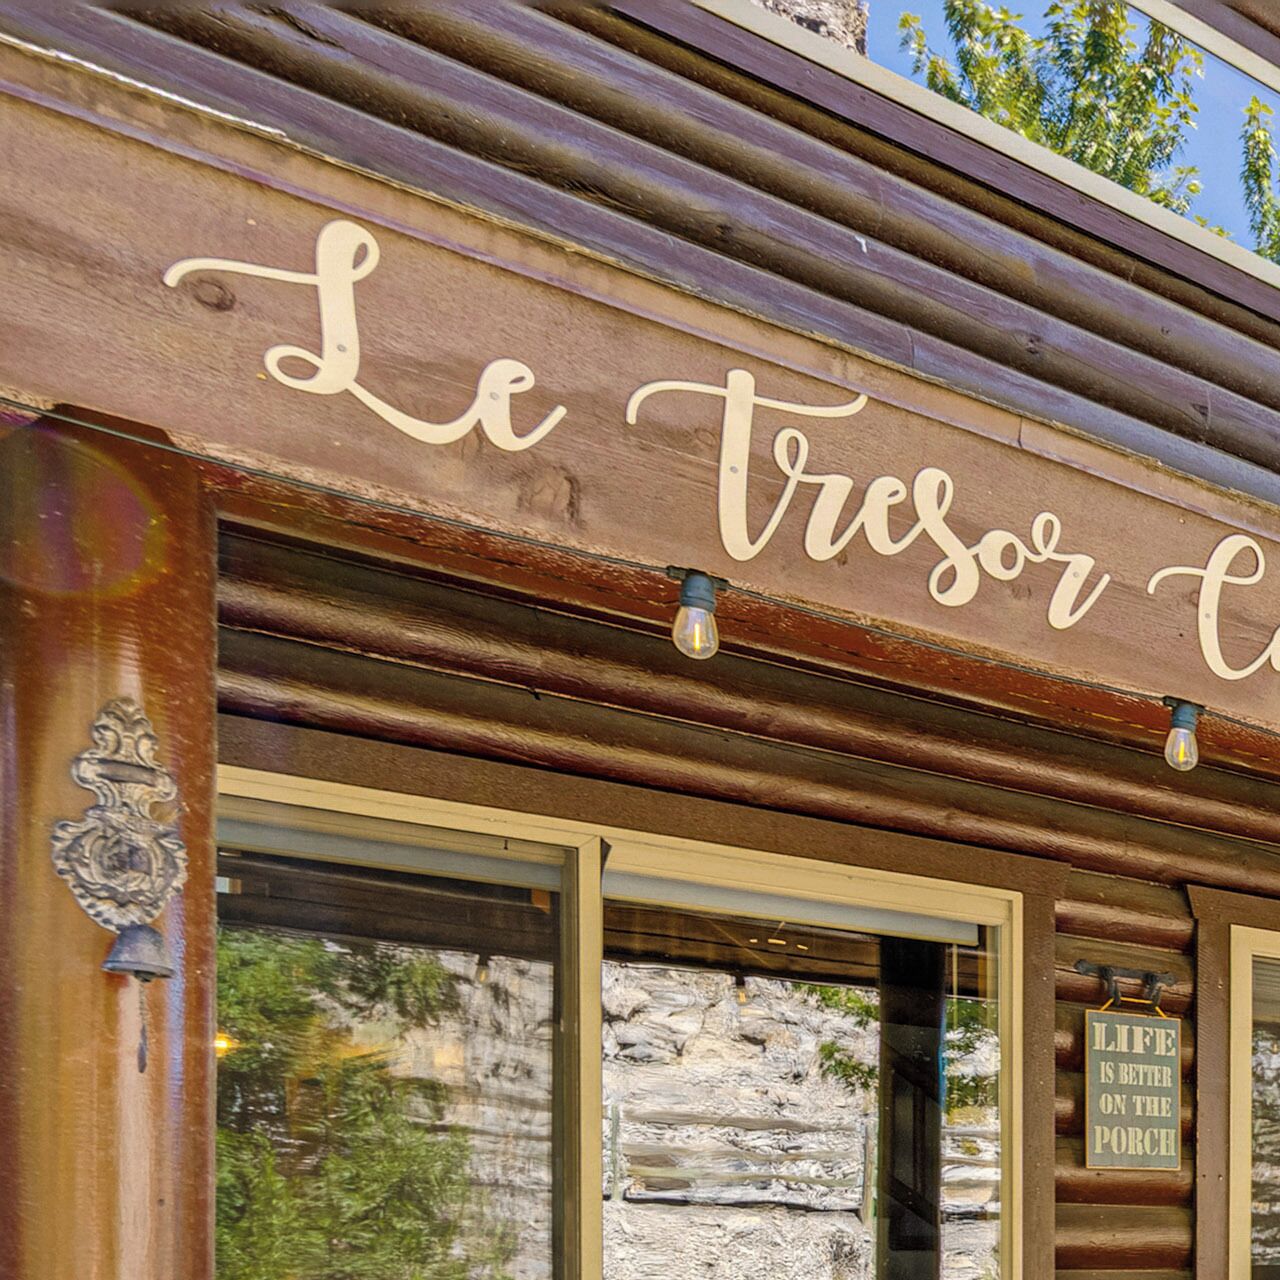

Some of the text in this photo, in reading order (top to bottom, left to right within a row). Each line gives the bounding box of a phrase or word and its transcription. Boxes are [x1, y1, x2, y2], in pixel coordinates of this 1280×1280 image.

[163, 219, 567, 452] Le
[626, 368, 1111, 630] Tresor
[1092, 1021, 1177, 1057] LIFE
[1100, 1061, 1173, 1088] IS BETTER
[1099, 1093, 1172, 1117] ON THE
[1094, 1125, 1177, 1156] PORCH
